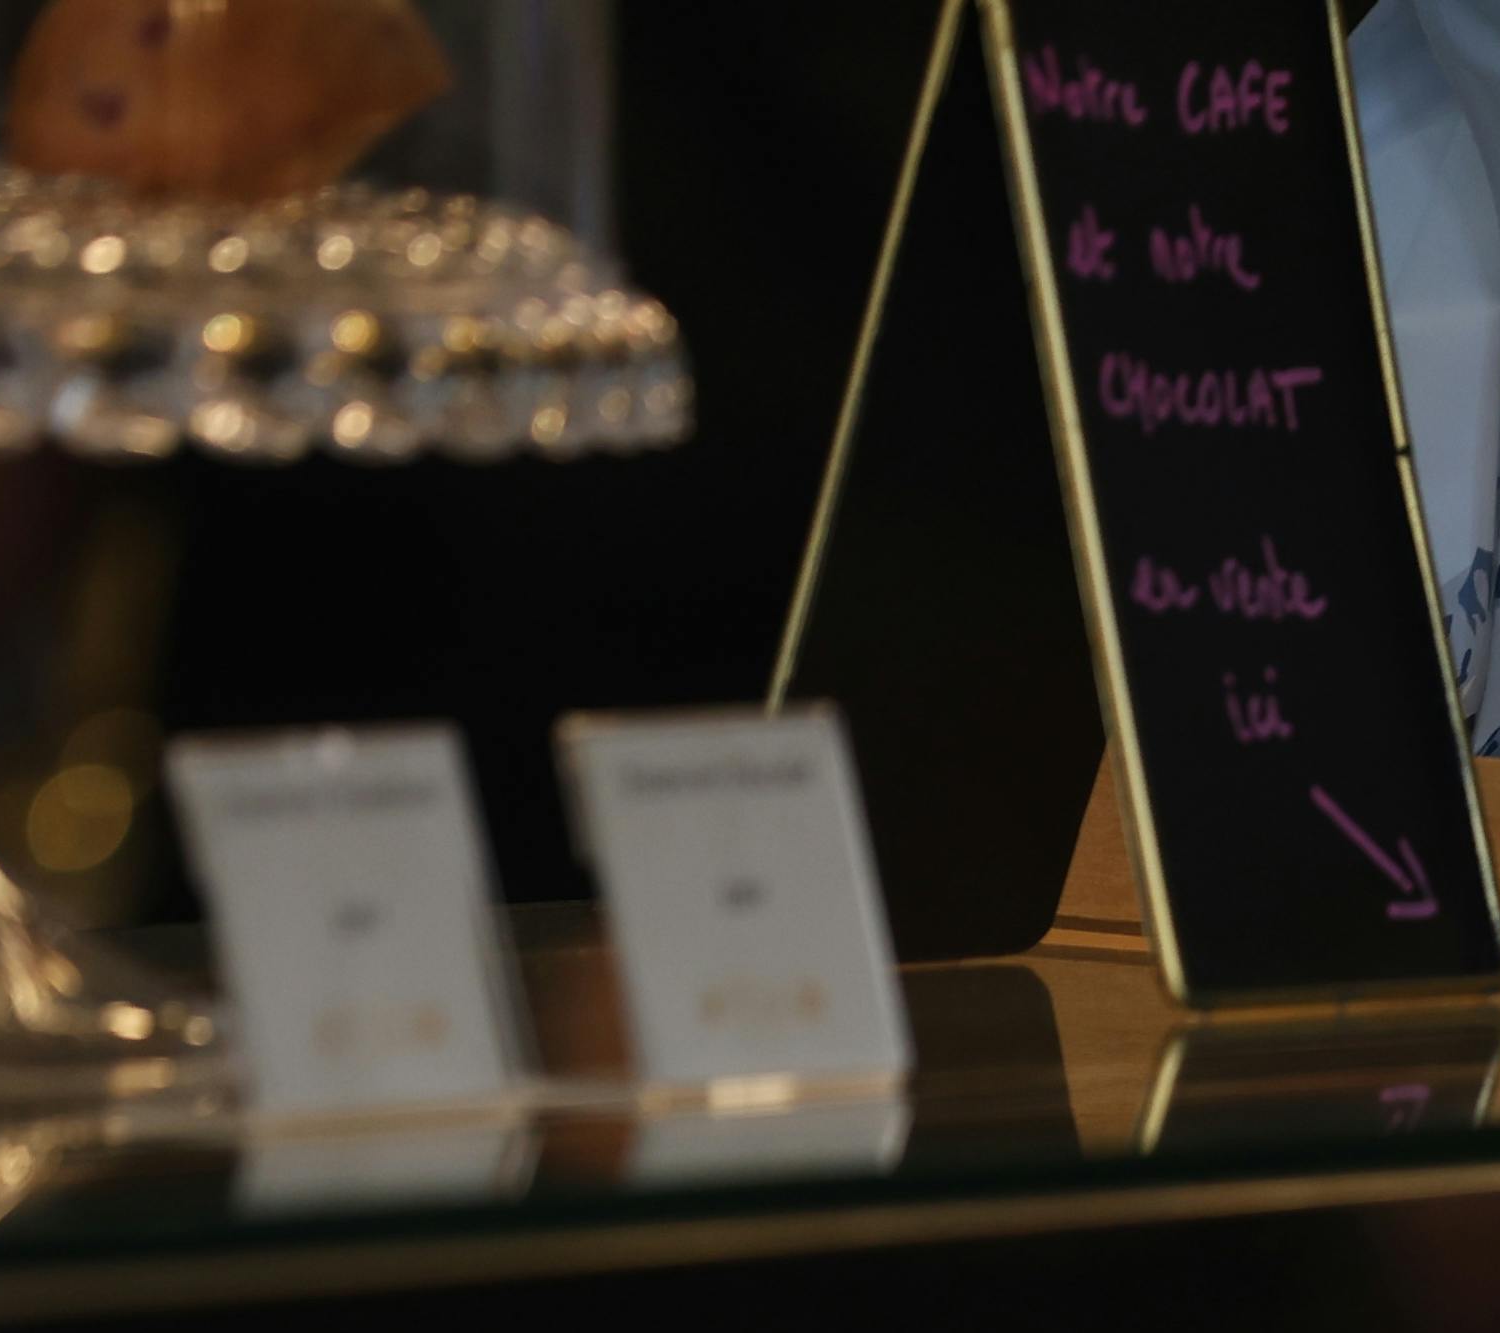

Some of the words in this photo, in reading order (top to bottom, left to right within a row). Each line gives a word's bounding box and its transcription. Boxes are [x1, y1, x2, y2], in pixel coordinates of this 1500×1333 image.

[1177, 58, 1293, 135] CAFE
[1099, 351, 1323, 436] CHOCOLAT
[1221, 665, 1295, 743] ici
